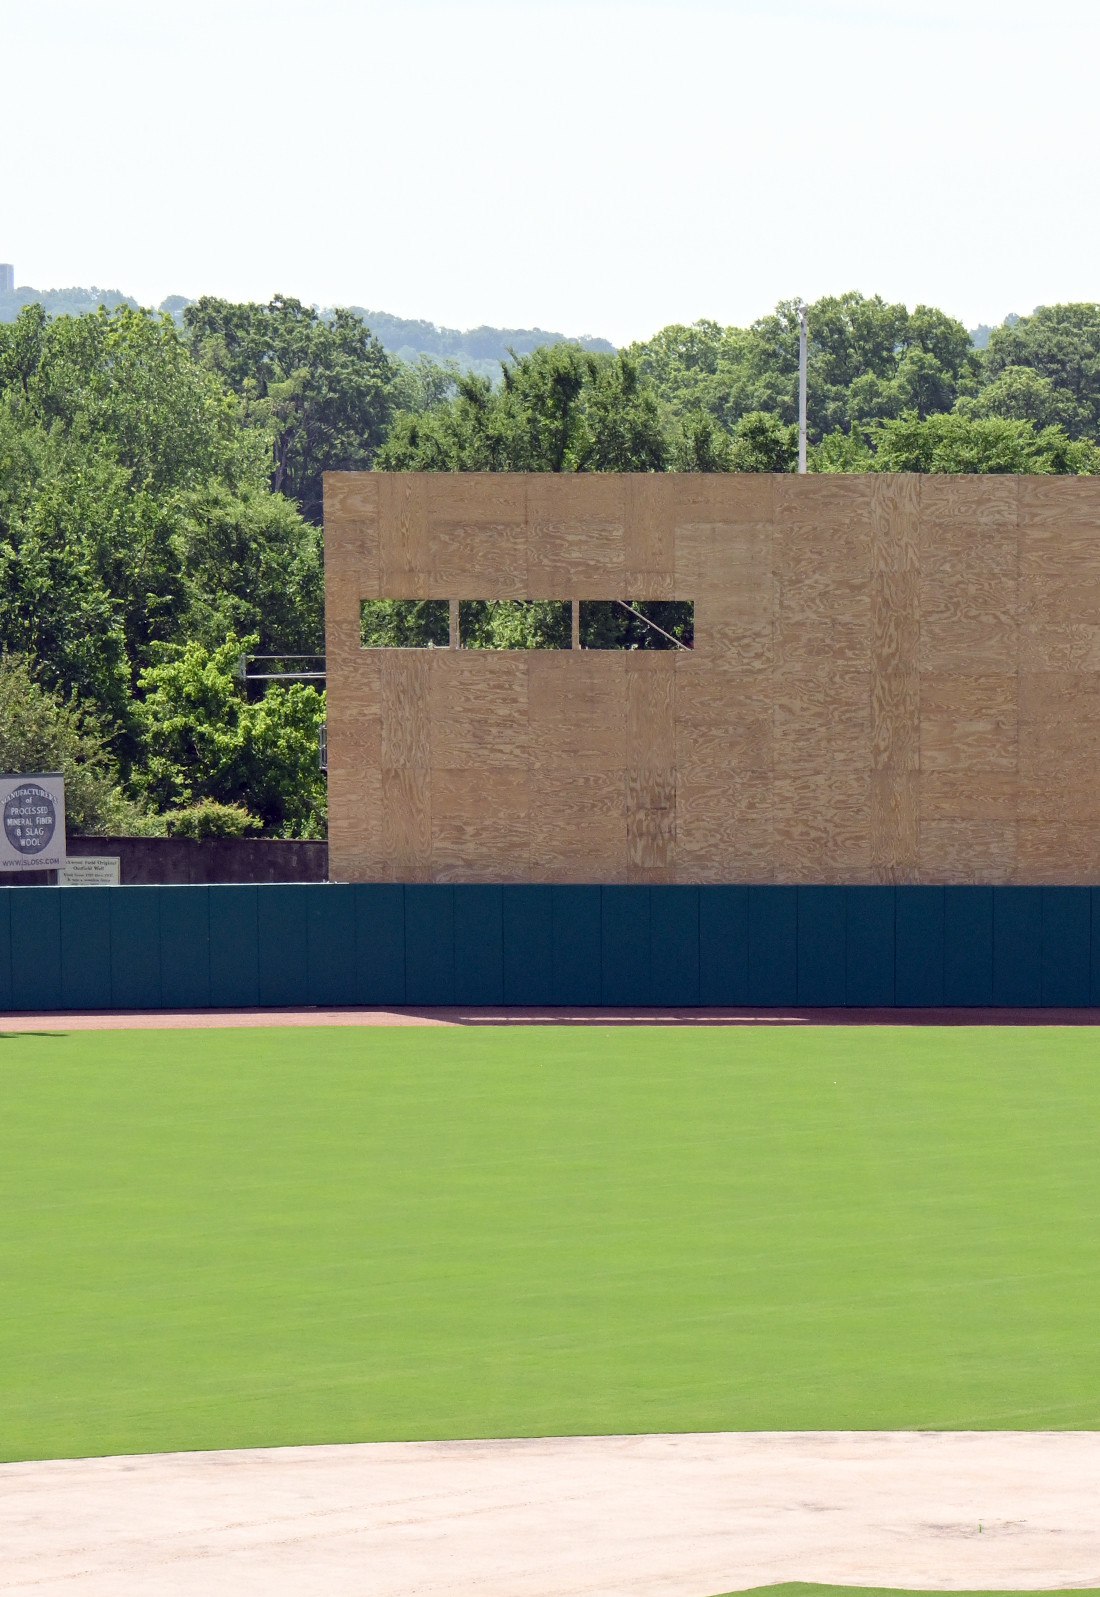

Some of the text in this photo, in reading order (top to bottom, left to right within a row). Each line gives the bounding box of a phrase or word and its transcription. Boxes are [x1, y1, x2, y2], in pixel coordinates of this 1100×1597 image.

[1, 788, 58, 805] MANUFACTURERS
[25, 796, 33, 804] of
[11, 807, 48, 815] PROCESSED
[6, 816, 53, 826] MINERAL FIBER
[16, 827, 45, 836] & SLAG
[20, 838, 42, 847] WOOL
